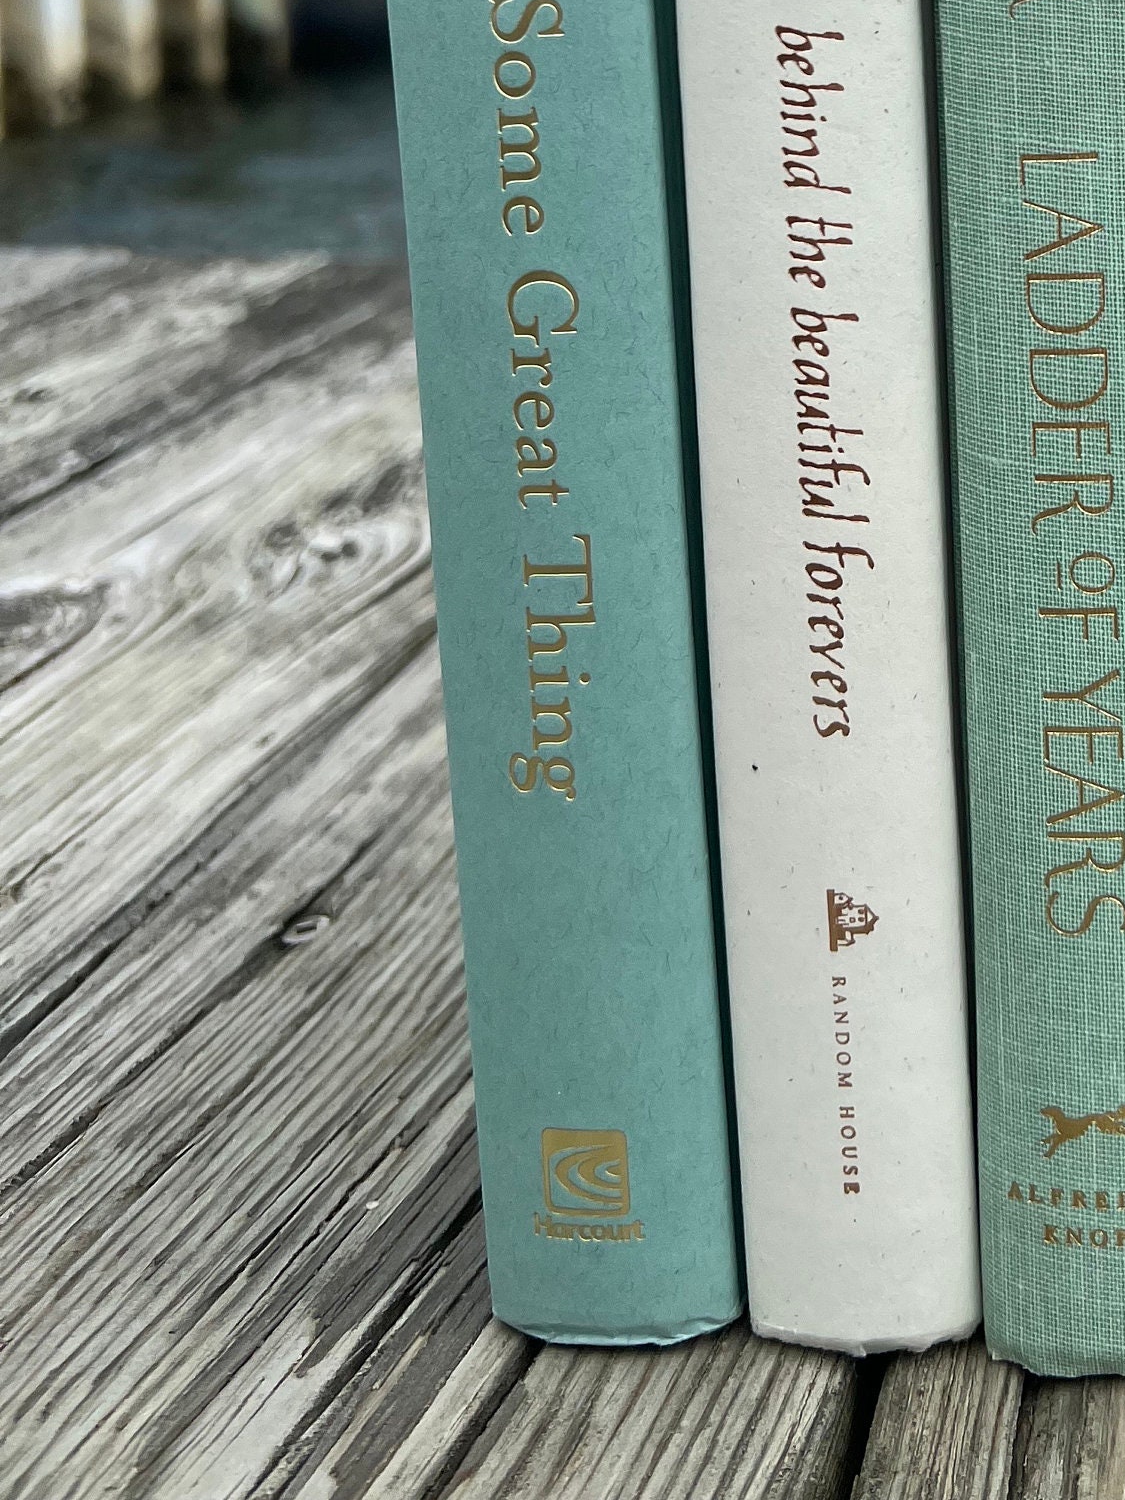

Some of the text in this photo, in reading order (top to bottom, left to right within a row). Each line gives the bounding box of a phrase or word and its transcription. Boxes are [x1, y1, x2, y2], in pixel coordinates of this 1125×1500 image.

[774, 25, 853, 195] behind
[785, 214, 854, 291] the
[1018, 151, 1116, 536] LADDER
[505, 269, 582, 510] Great
[789, 306, 871, 524] beautiful
[507, 533, 596, 802] Thing
[801, 541, 875, 740] forevers
[1038, 550, 1120, 642] OF
[831, 975, 861, 1196] RANDOM HOUSE
[533, 1211, 646, 1242] Harcourt
